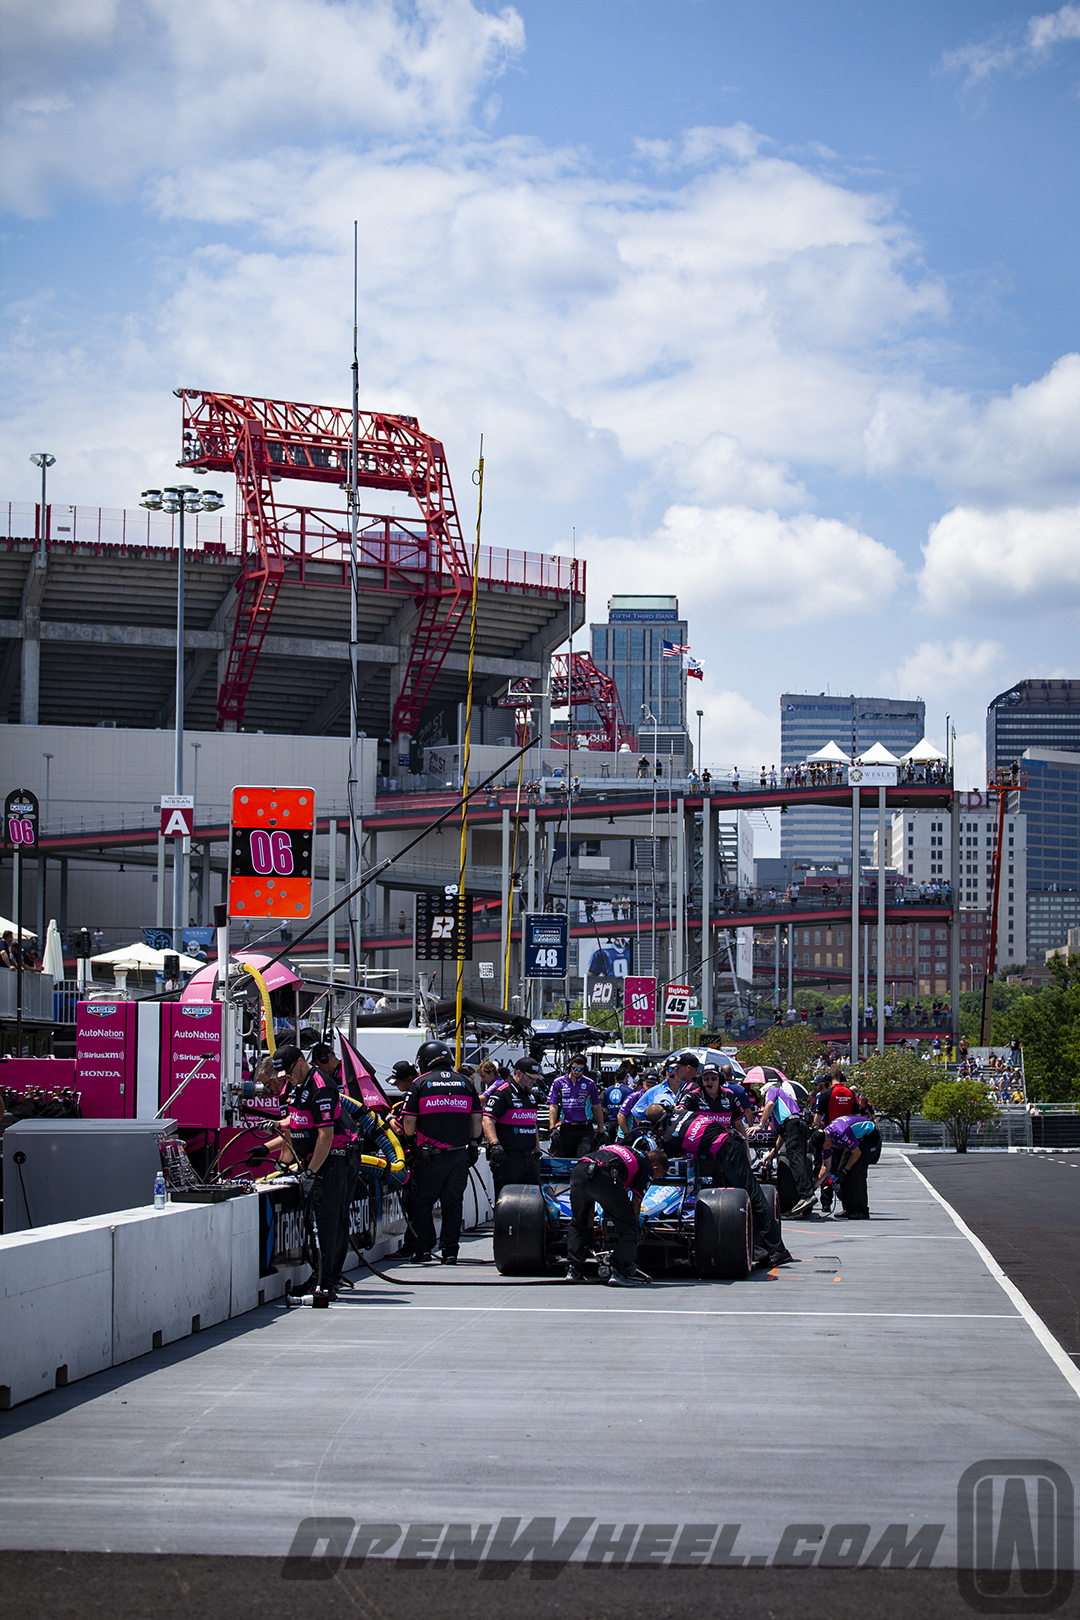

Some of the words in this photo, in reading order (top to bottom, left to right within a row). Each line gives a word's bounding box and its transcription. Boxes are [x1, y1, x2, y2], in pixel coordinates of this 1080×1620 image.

[164, 810, 190, 835] A
[9, 819, 35, 845] 06
[249, 829, 295, 876] 06
[430, 915, 455, 939] 52
[535, 949, 558, 968] 48
[591, 982, 613, 1003] 20
[631, 993, 649, 1010] 60
[668, 998, 687, 1012] 45
[79, 1029, 124, 1039] AutoNation
[174, 1030, 219, 1040] AutoNation
[179, 1053, 215, 1061] Sirius
[426, 1099, 468, 1108] AutoNation
[512, 1112, 537, 1120] AutoNat
